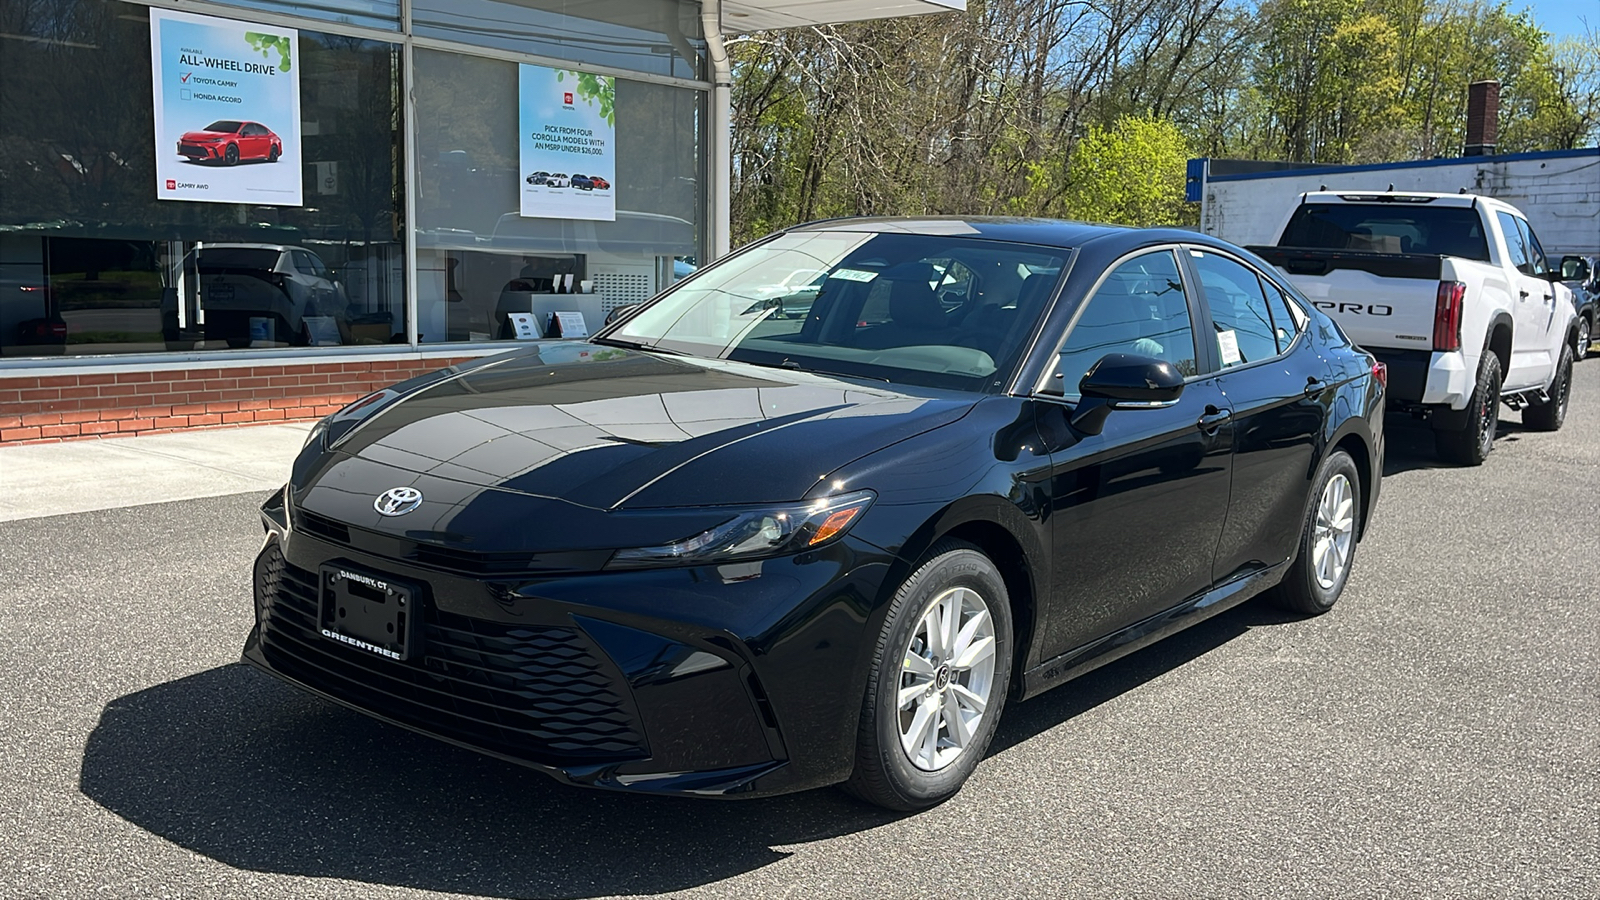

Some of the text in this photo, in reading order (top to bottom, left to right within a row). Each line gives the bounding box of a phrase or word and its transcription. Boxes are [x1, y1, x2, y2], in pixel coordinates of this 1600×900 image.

[180, 54, 275, 76] ALL-WHEEL DRIVE
[193, 77, 238, 88] TOYOTA CAMRY
[194, 92, 242, 104] HONDA ACCORD
[544, 125, 558, 133] PICK
[559, 126, 576, 135] FROM
[532, 132, 604, 146] COROLLA MODELS WITH
[582, 147, 603, 156] $26,000.
[1313, 301, 1393, 316] PRO
[340, 570, 388, 590] DANBURY, CT
[322, 629, 400, 660] GREENTREE
